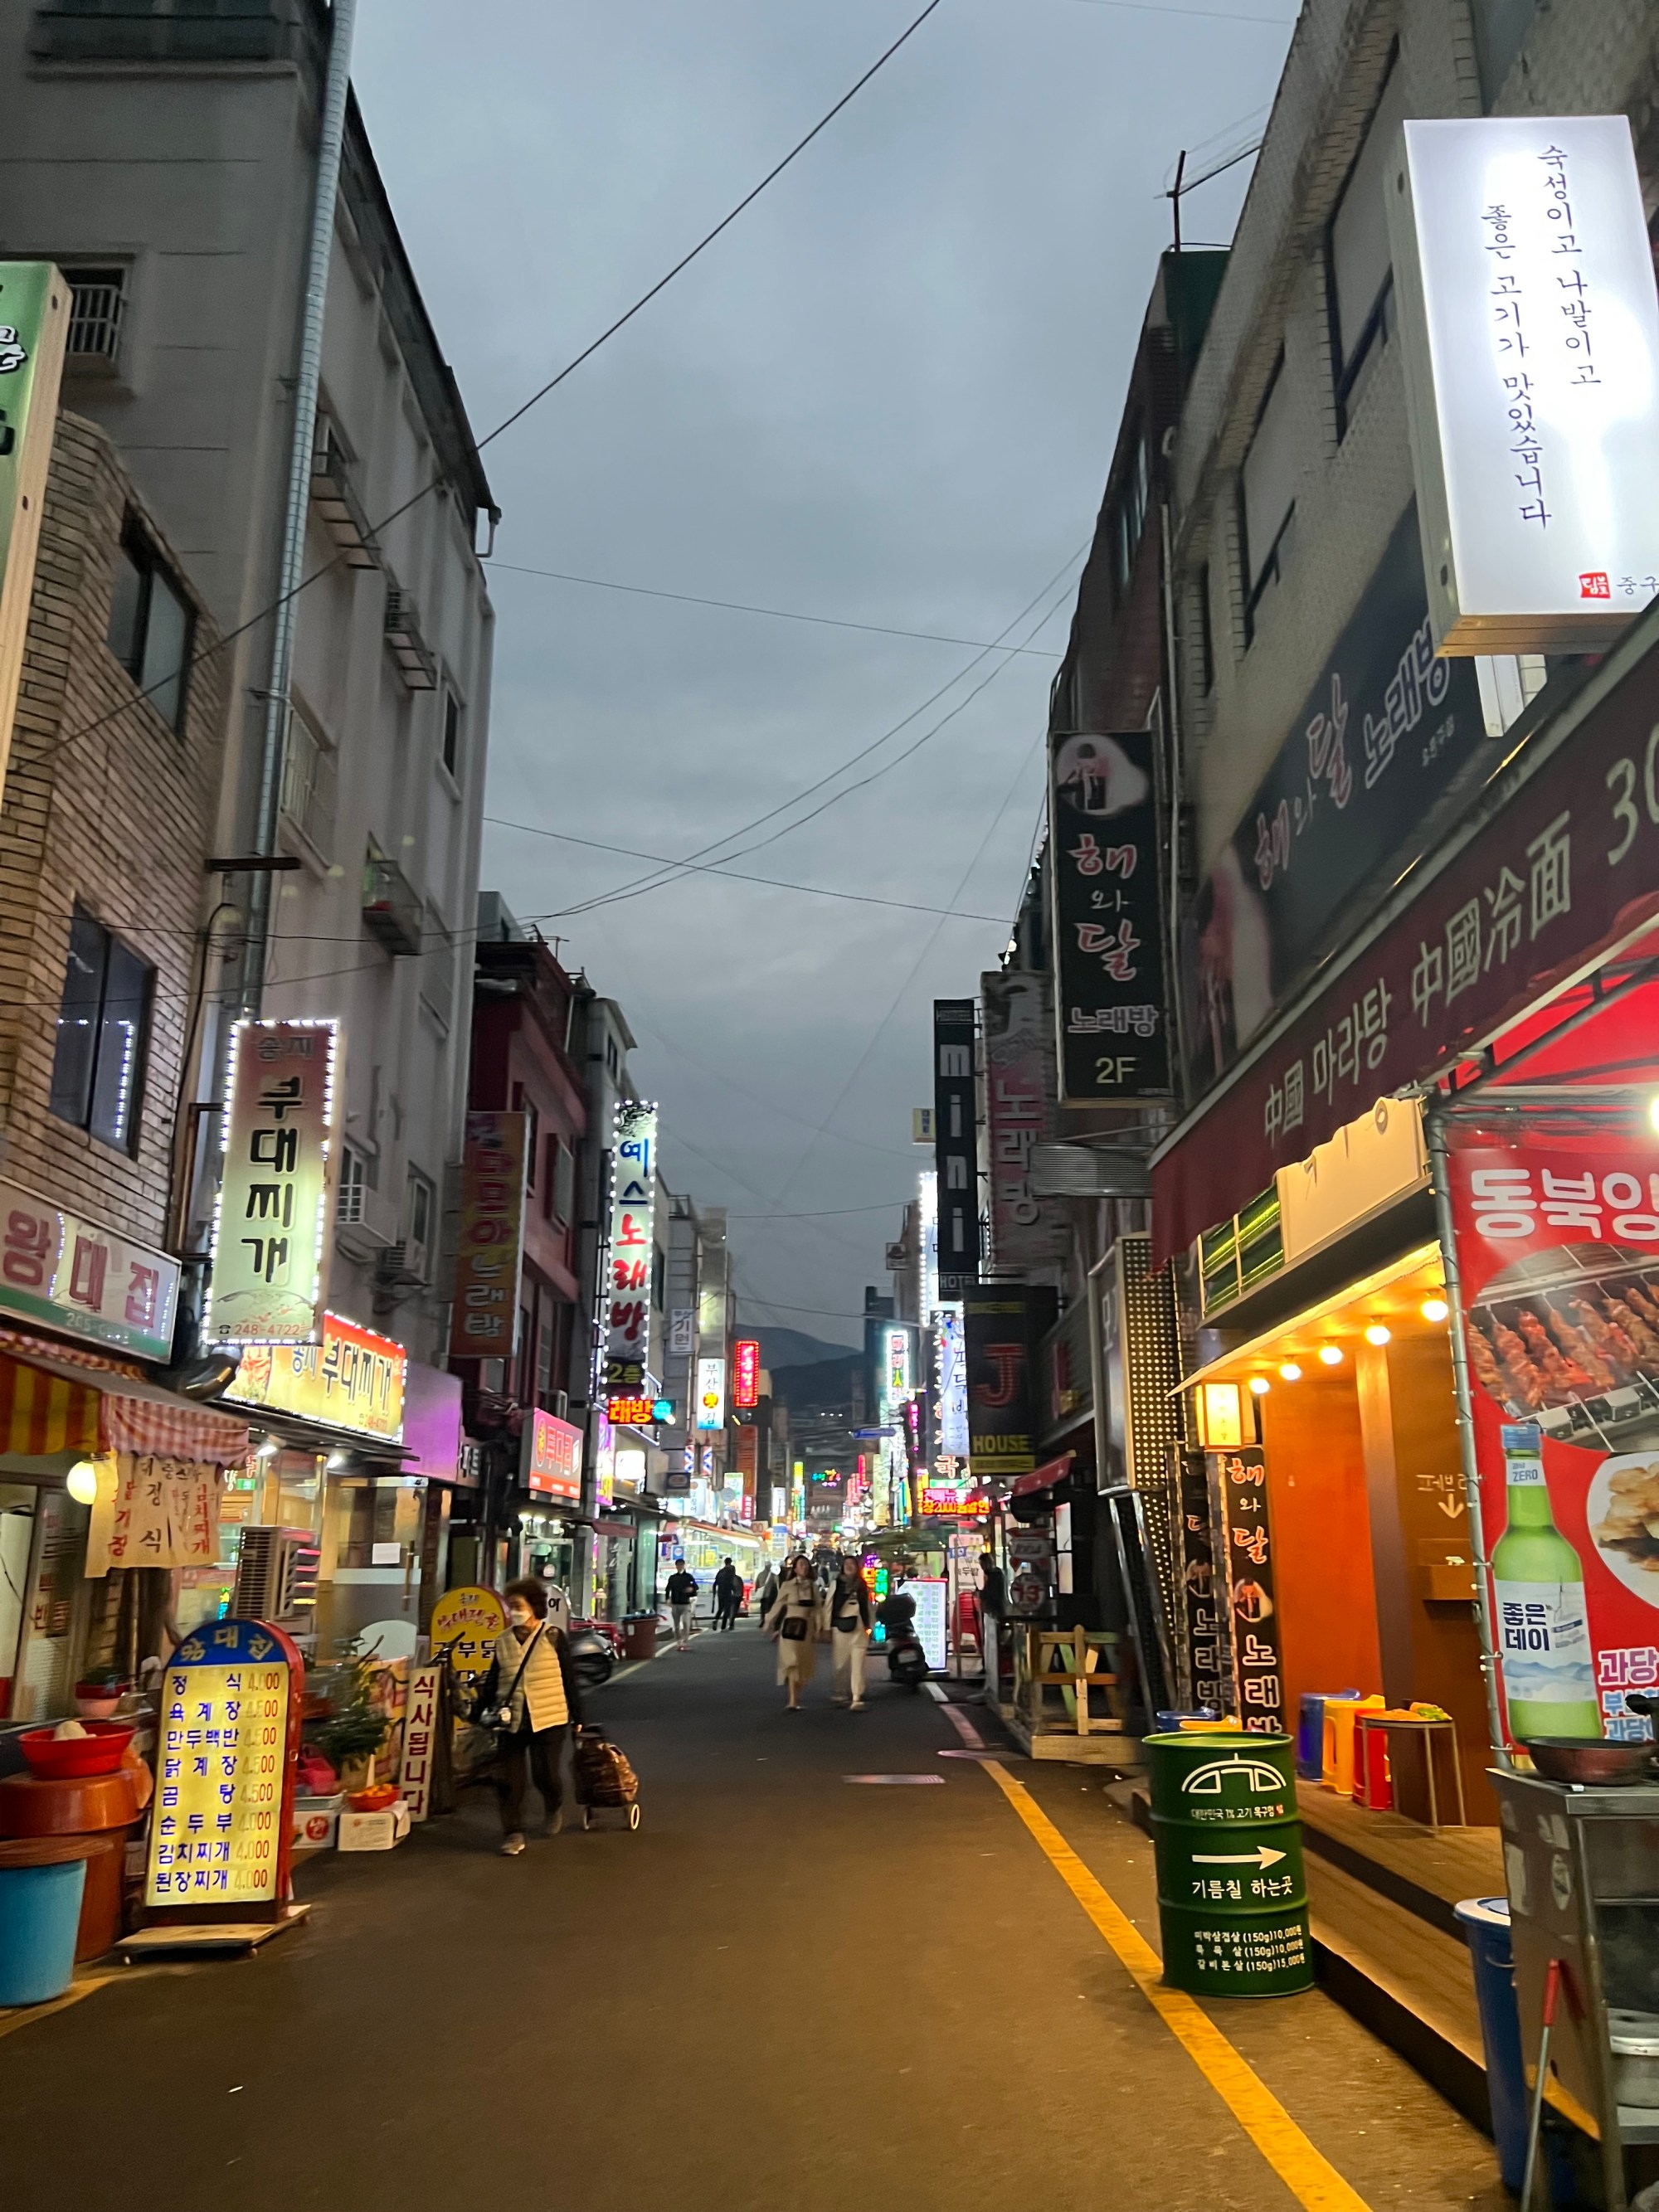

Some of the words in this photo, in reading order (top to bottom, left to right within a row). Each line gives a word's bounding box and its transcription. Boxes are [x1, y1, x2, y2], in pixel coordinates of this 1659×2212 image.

[1538, 145, 1583, 254] 숙성이고
[1481, 204, 1515, 259] 좋은
[1491, 275, 1529, 358] 고기가
[1556, 270, 1601, 384] 나발이고
[1502, 372, 1552, 529] 맛있습니다
[1068, 1004, 1159, 1037] 노래방
[1095, 1057, 1136, 1084] 2F
[1265, 1059, 1305, 1150] 中國
[1312, 977, 1393, 1106] 마라탕
[939, 1043, 971, 1253] mini
[996, 1080, 1043, 1225] 노래방
[241, 1076, 304, 1285] 부대찌개
[619, 1137, 649, 1206] 예스
[610, 1213, 647, 1340] 노래방
[233, 1324, 300, 1337] 248-4722
[322, 1340, 392, 1412] 부대찌개
[608, 1362, 644, 1385] 2층
[975, 1344, 1025, 1407] J
[972, 1434, 1030, 1454] HOUSE
[1512, 1469, 1538, 1482] ZERO
[1226, 1456, 1269, 1564] 해와달
[1502, 1602, 1547, 1626] 좋은
[1504, 1628, 1550, 1651] 데이
[172, 1673, 241, 1695] 정식
[167, 1728, 240, 1750] 만두백반
[402, 1675, 435, 1815] 식사됩니다
[163, 1784, 236, 1806] 곰탕
[160, 1813, 232, 1835] 순두부
[1236, 1807, 1253, 1819] 고기
[158, 1841, 231, 1864] 김치찌개
[155, 1869, 228, 1893] 된장찌개
[1191, 1879, 1243, 1900] 기름칠
[1250, 1875, 1293, 1898] 하는곳
